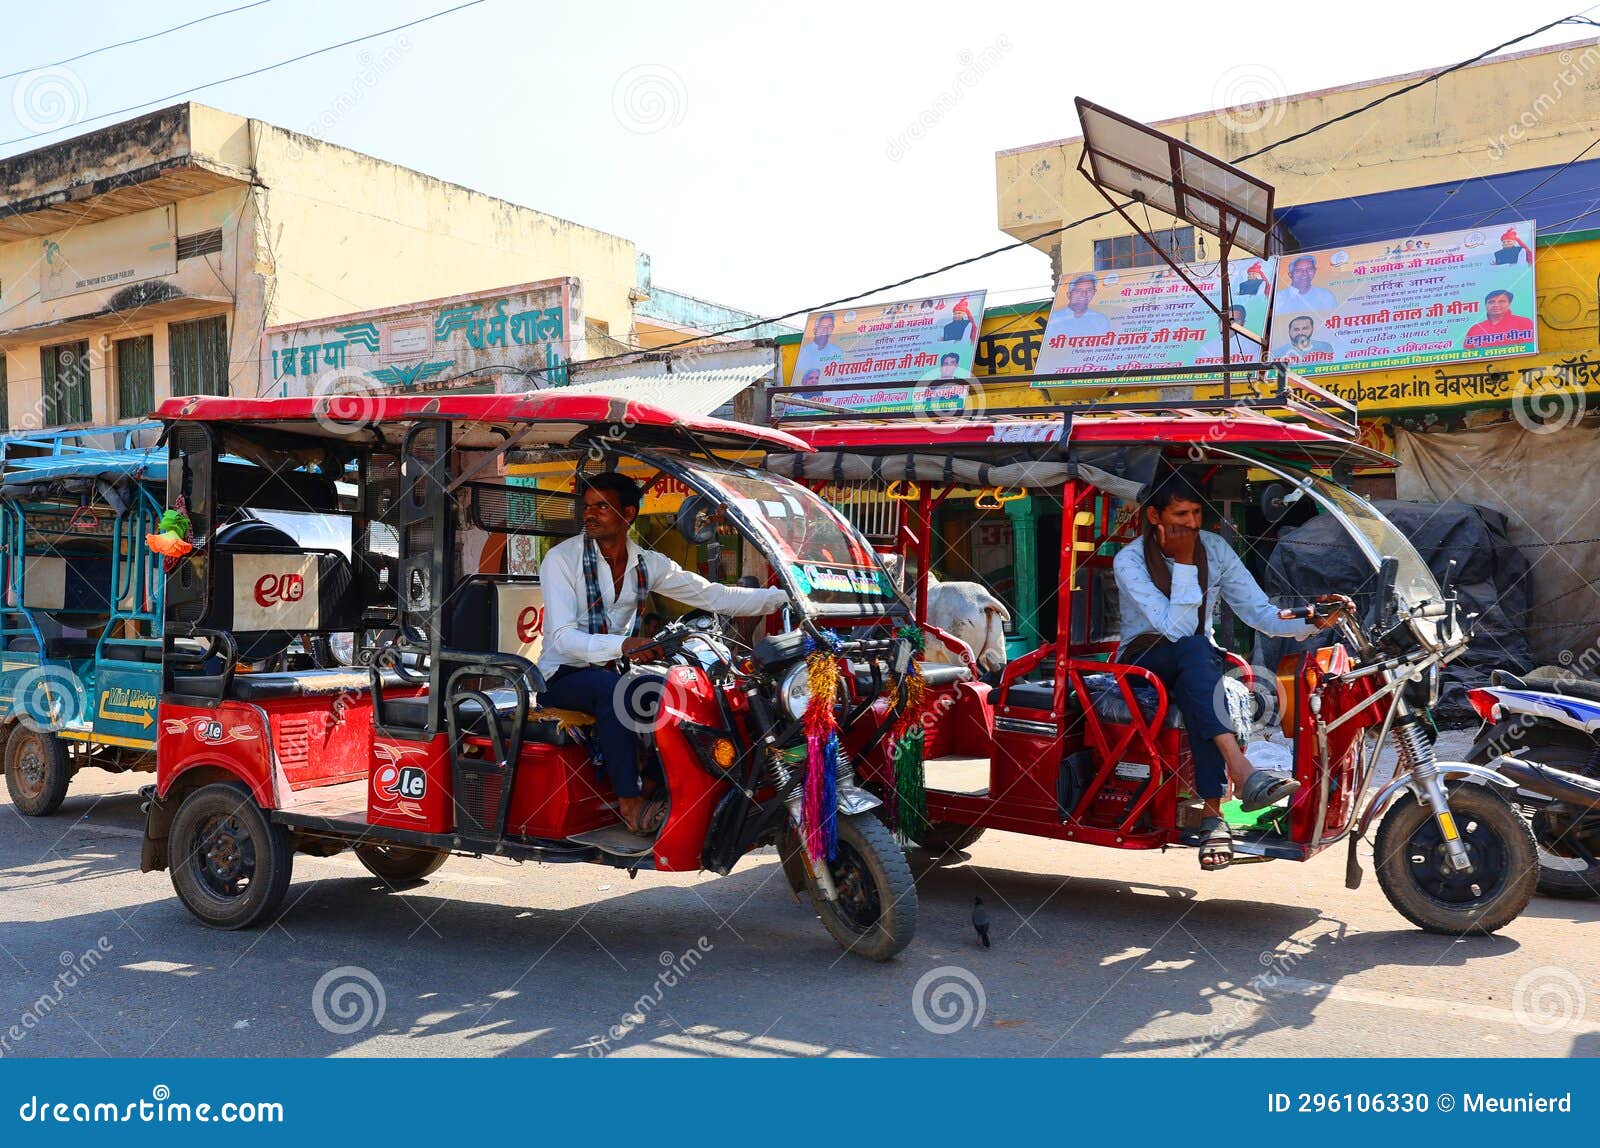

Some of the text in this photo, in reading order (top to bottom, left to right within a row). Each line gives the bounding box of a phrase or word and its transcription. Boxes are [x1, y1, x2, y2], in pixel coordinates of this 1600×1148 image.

[1370, 263, 1404, 273] अशोक
[1408, 257, 1422, 268] जी
[1426, 253, 1465, 265] गहलोत
[1370, 279, 1404, 293] हार्दिक
[1409, 276, 1447, 287] आभार
[1325, 301, 1480, 329] श्री परसादी लाल जी मीना
[1049, 333, 1066, 349] श्री
[1067, 331, 1115, 348] परसादी
[1118, 331, 1148, 345] लाल
[1150, 328, 1171, 343] जी
[1173, 326, 1207, 342] मीना
[1464, 329, 1532, 347] हनुमान मीना
[1344, 345, 1390, 360] नागरिक
[824, 360, 836, 377] श्री
[838, 357, 872, 376] परसादी
[874, 357, 895, 371] लाल
[897, 354, 914, 369] जी
[914, 353, 939, 368] मीना
[108, 687, 128, 707] Mini
[374, 764, 427, 801] ele
